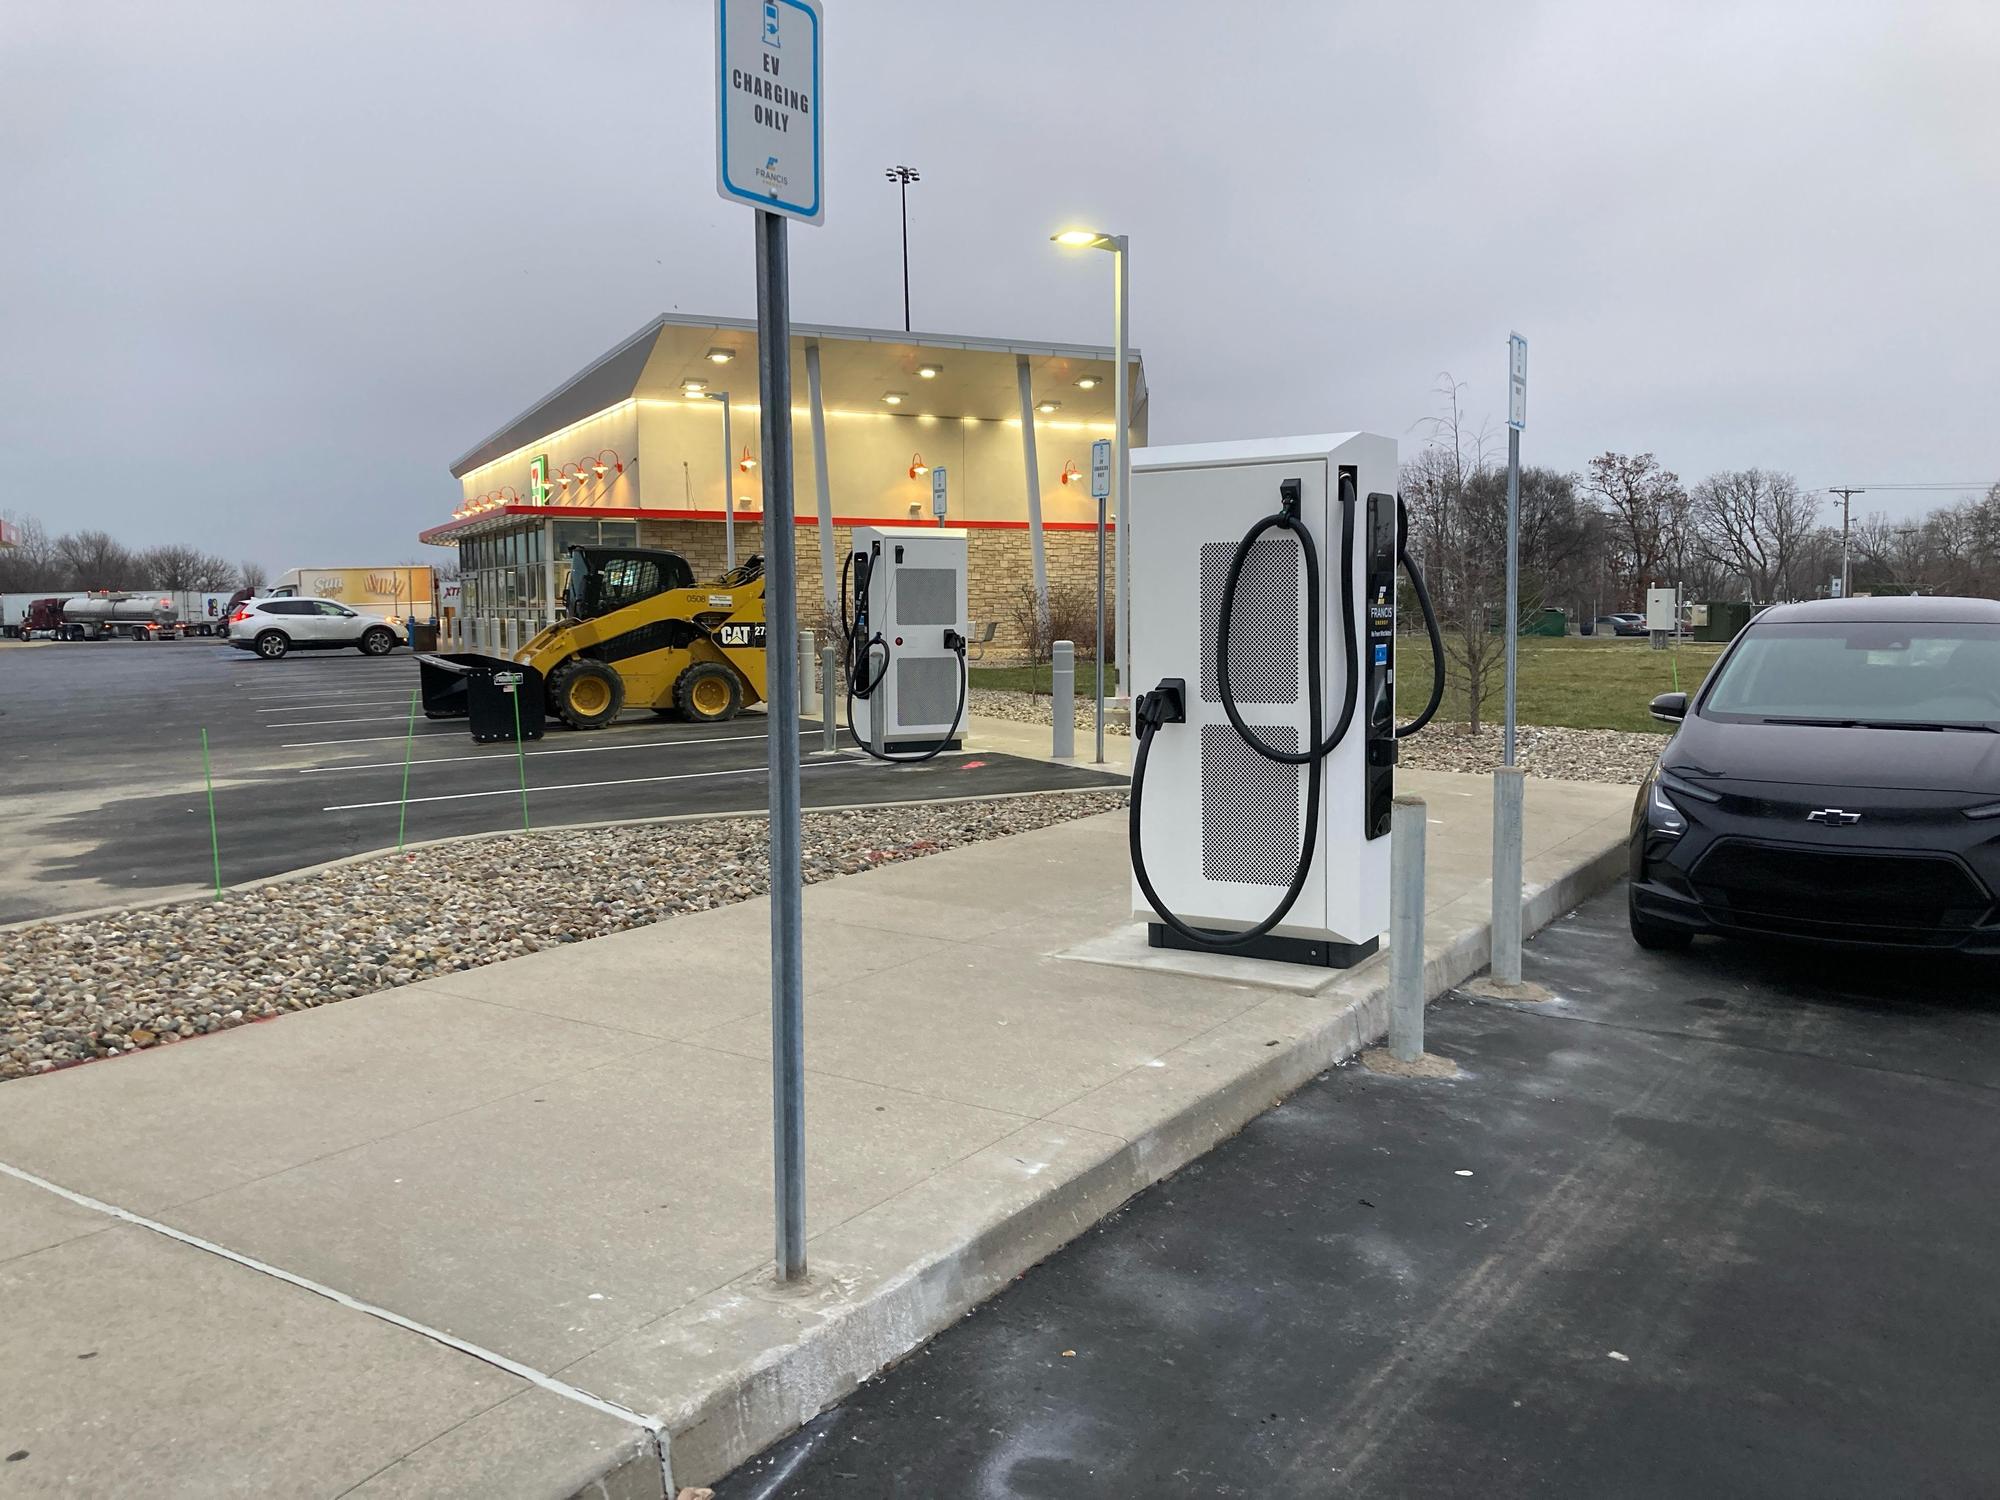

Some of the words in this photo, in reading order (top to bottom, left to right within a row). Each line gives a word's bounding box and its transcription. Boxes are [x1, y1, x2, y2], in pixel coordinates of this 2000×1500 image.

[763, 53, 780, 76] EV
[732, 68, 809, 114] CHARGING
[754, 104, 789, 133] ONLY
[755, 167, 789, 186] FRANCIS
[1370, 607, 1393, 618] FRANCIS
[720, 626, 751, 645] CAT
[754, 626, 767, 636] 27
